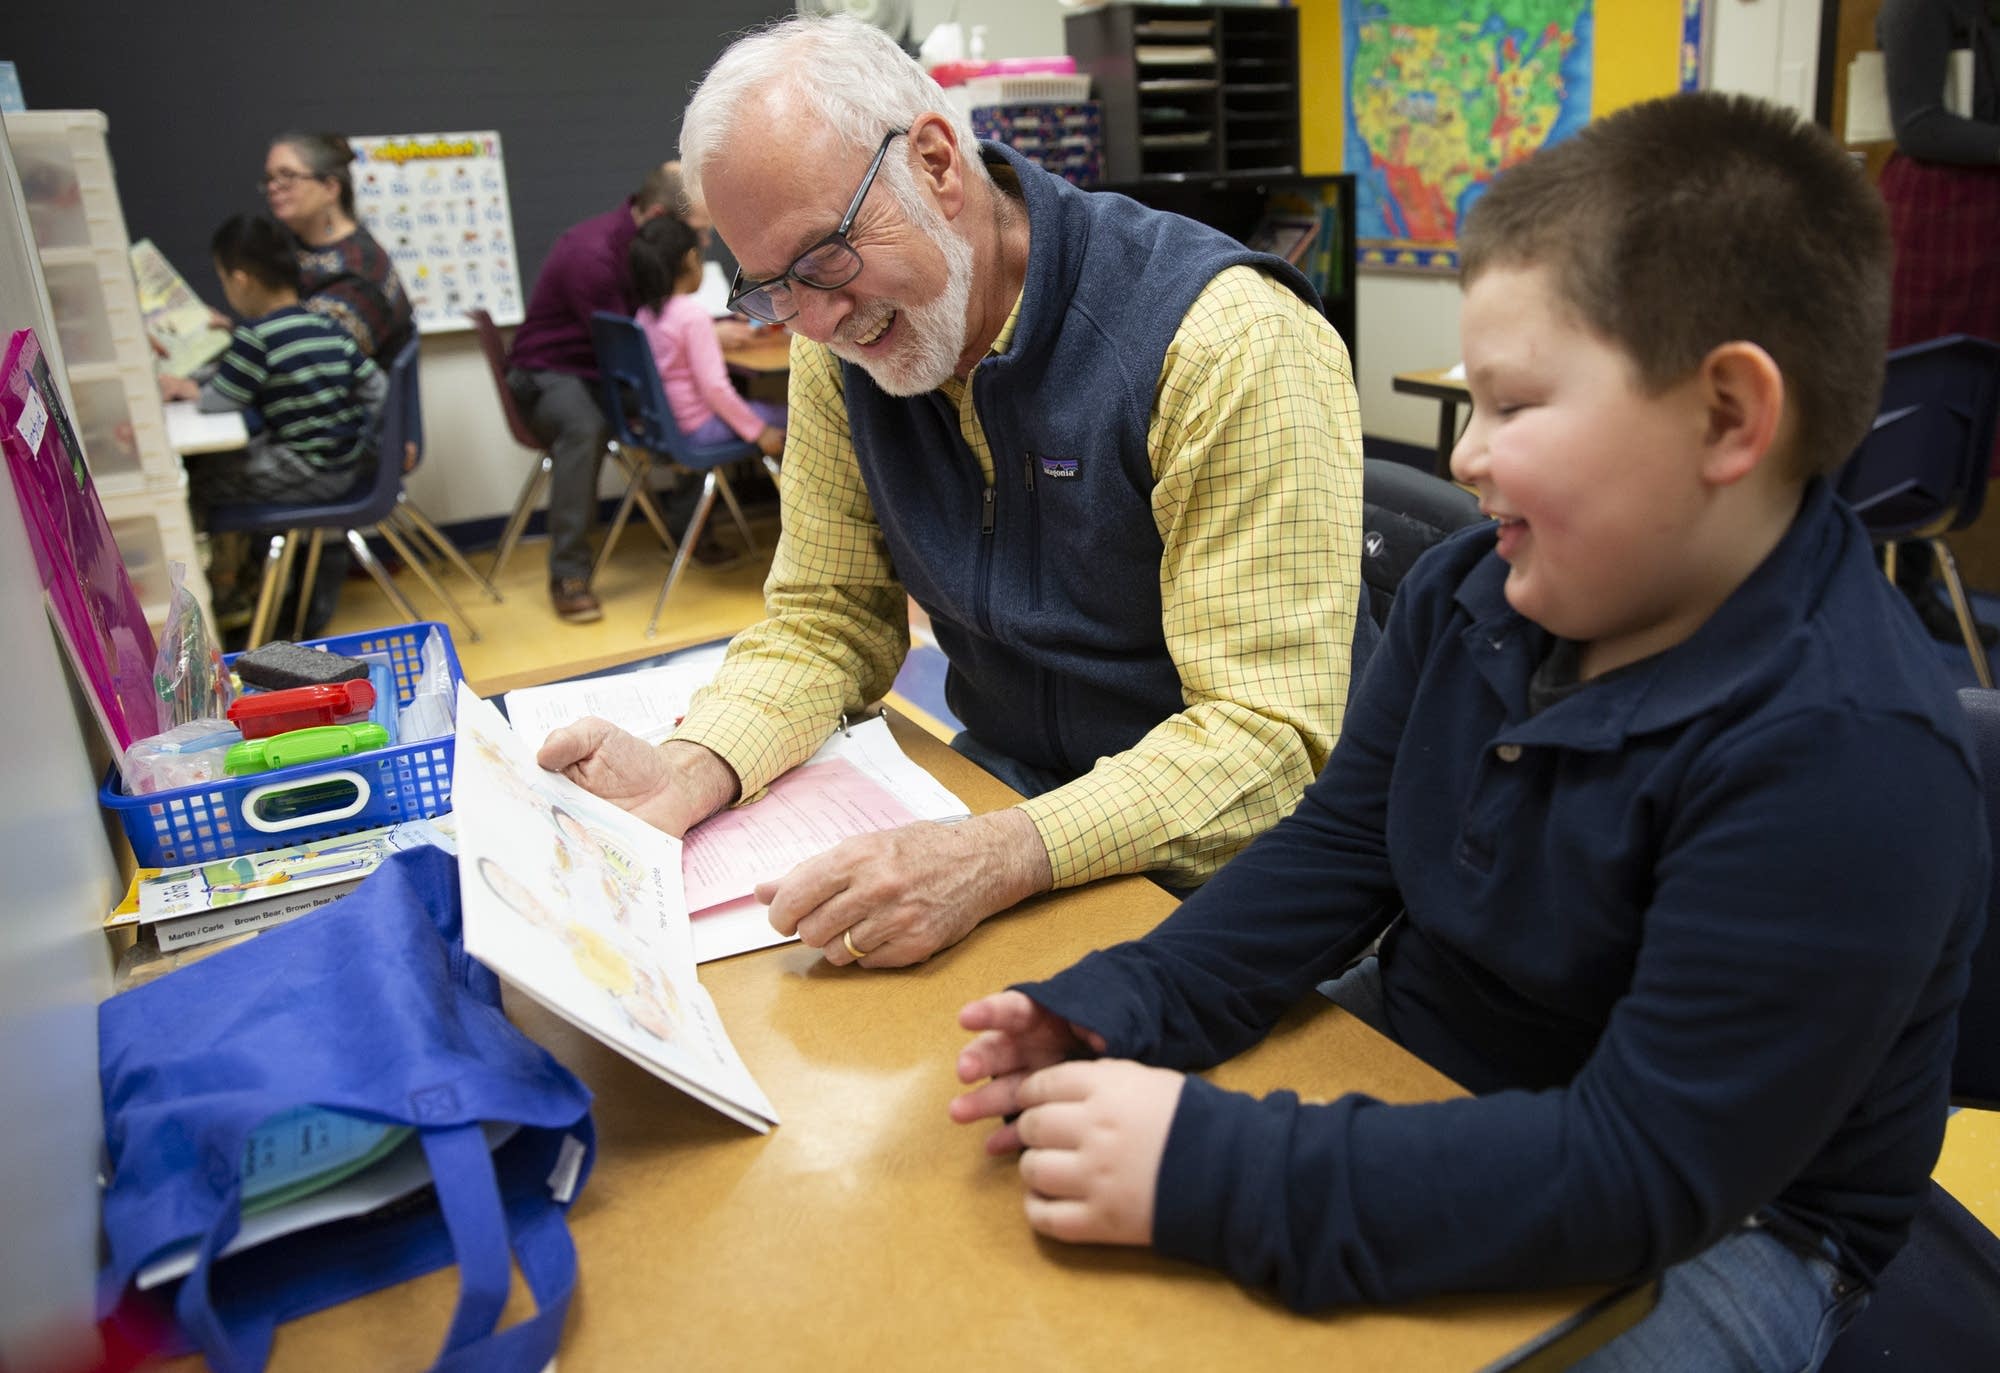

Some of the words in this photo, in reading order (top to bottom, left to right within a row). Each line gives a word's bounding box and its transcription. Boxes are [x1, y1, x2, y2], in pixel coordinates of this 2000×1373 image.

[168, 930, 196, 941] Martin
[202, 923, 224, 933] Carle
[234, 914, 261, 926] Brown
[262, 910, 284, 918] Bear,
[285, 902, 311, 913] Brown
